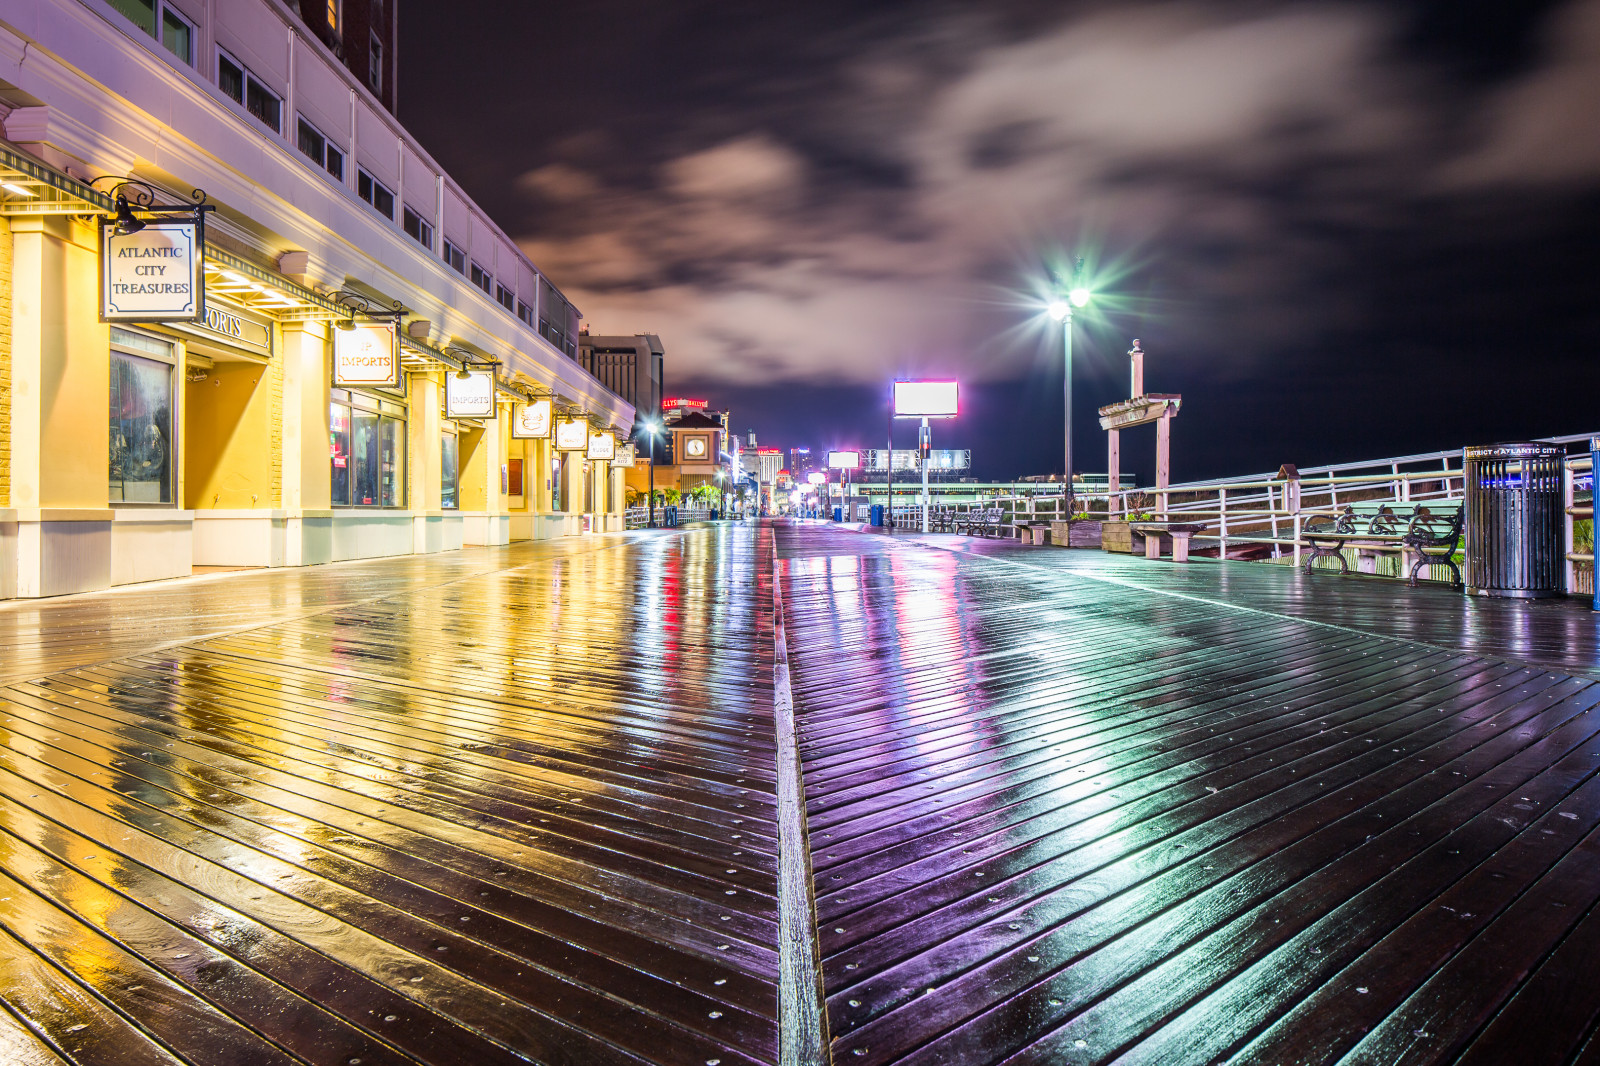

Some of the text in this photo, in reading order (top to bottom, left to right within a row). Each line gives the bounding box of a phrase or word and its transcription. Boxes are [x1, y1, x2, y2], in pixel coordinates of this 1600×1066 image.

[118, 247, 183, 258] ATLANTIC
[135, 265, 167, 276] CITY
[113, 283, 189, 294] TREASURES
[341, 356, 391, 367] IMPORTS
[452, 396, 489, 404] IMPORTS
